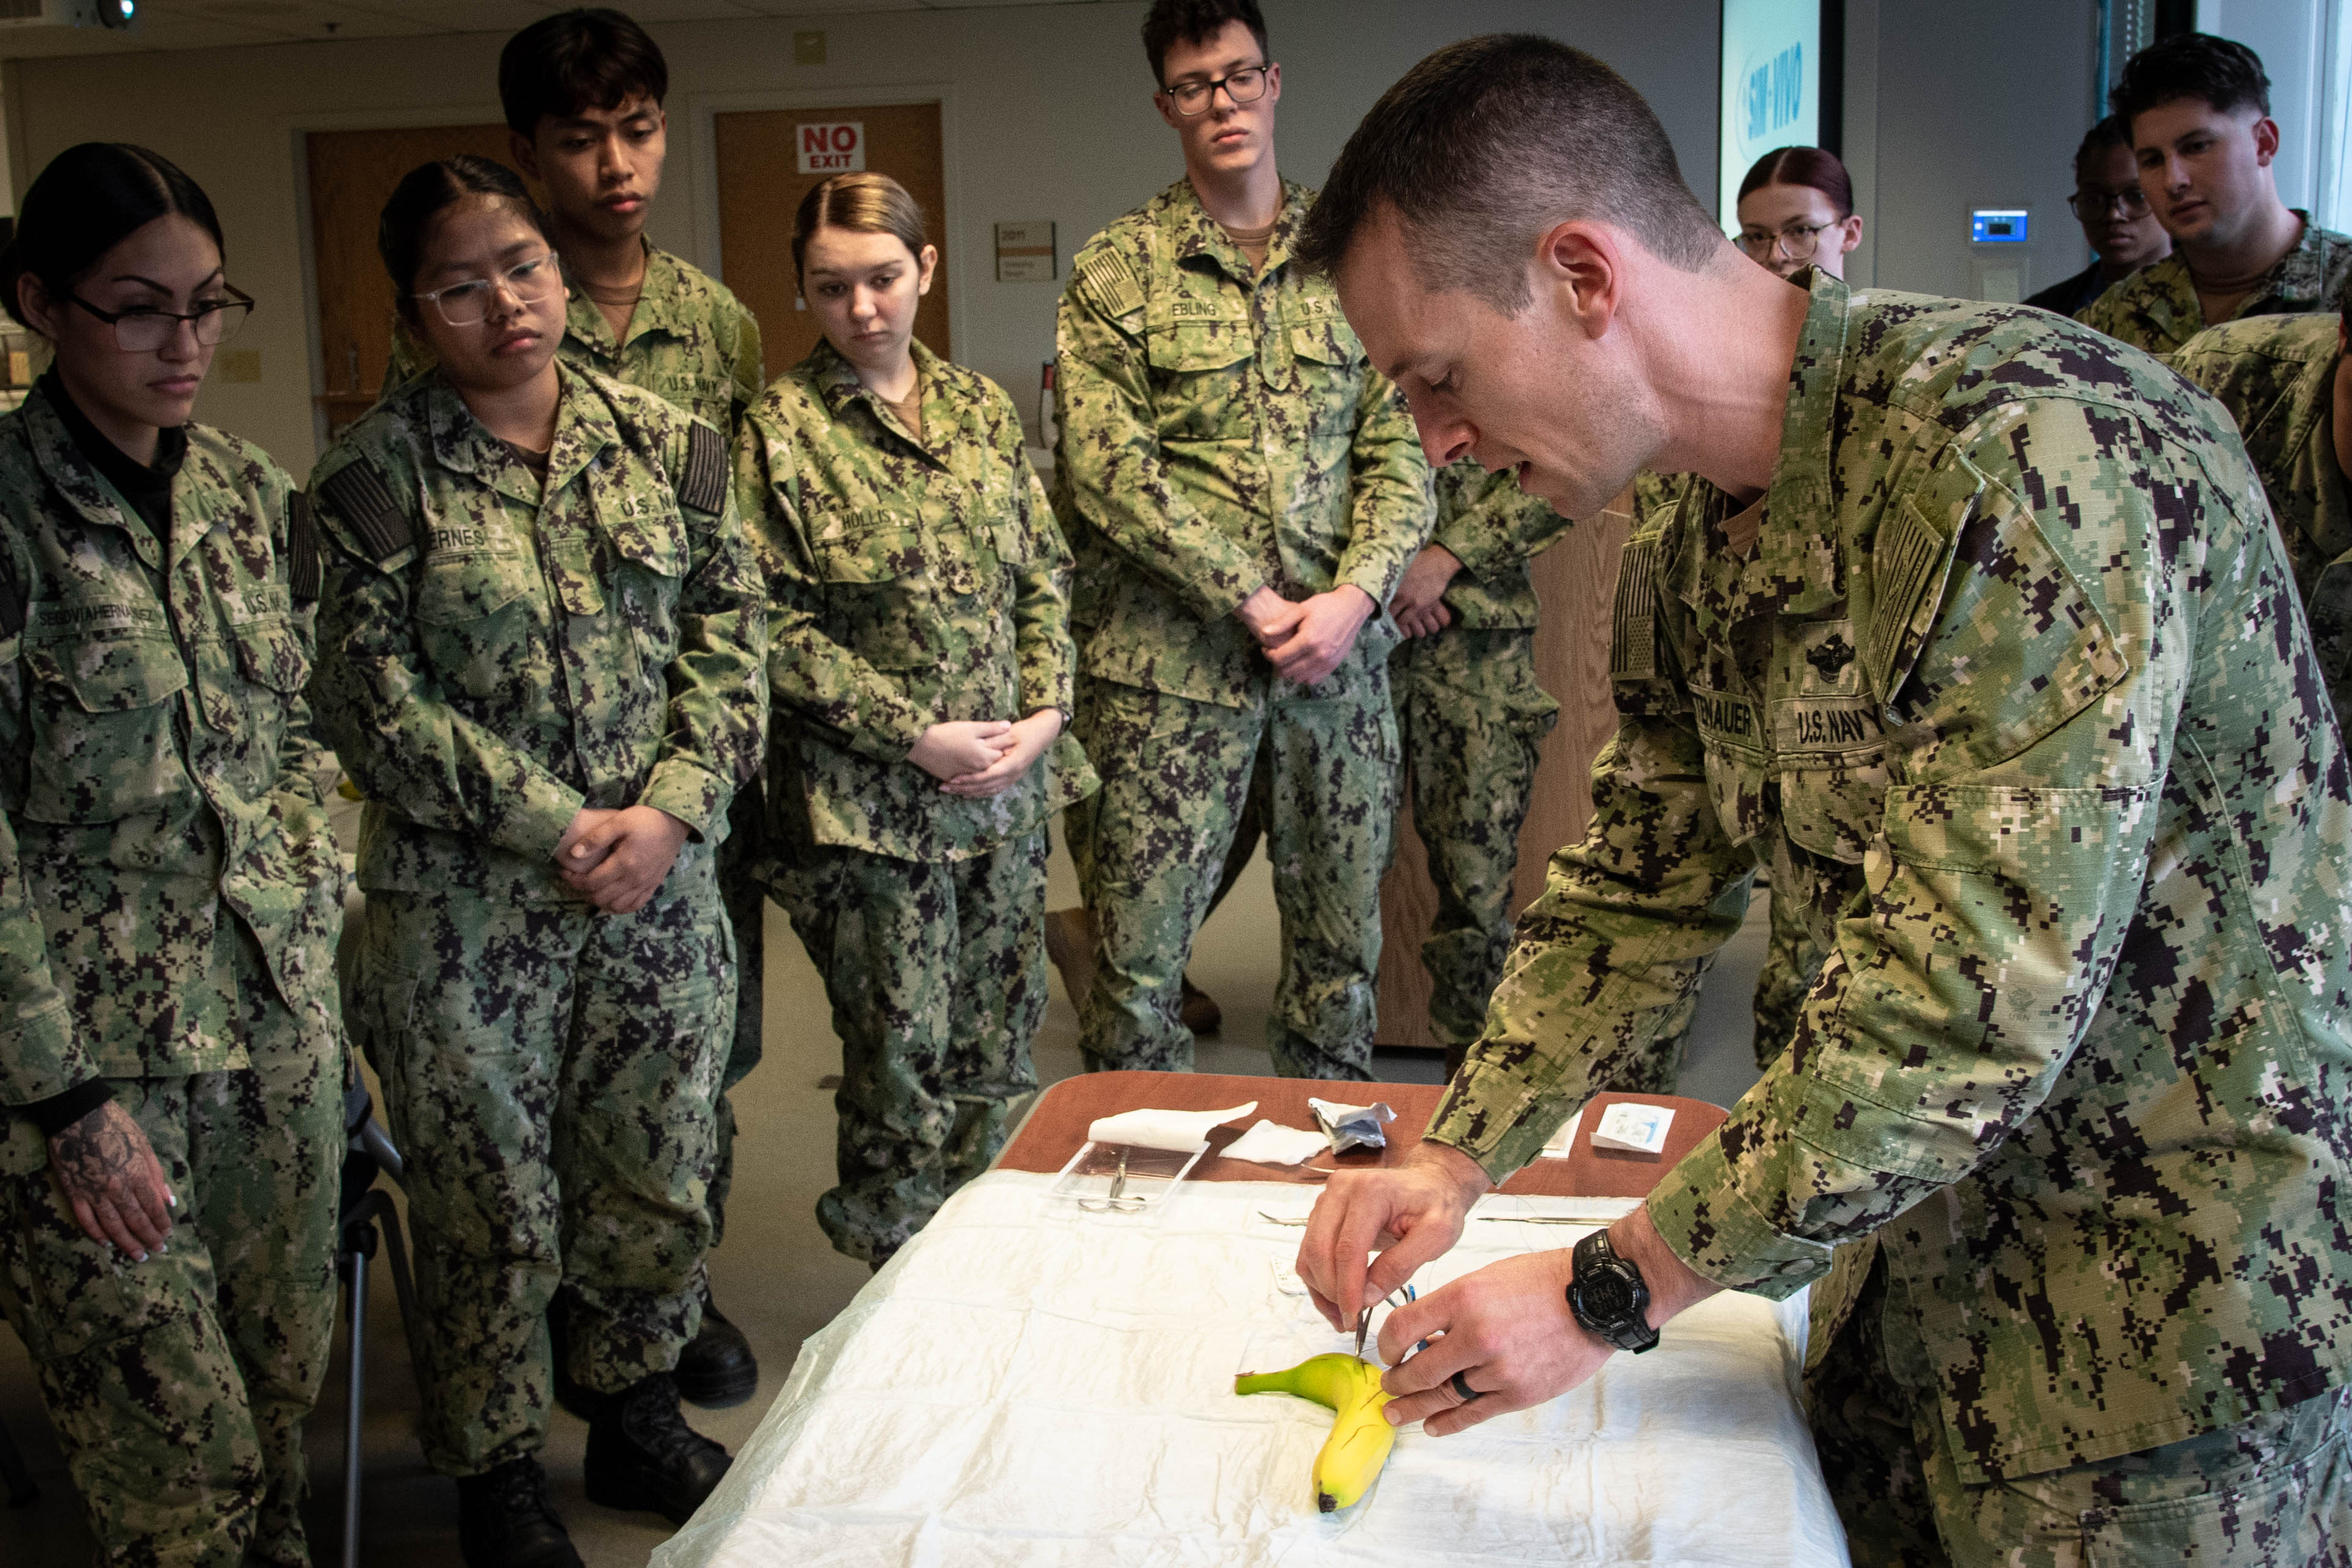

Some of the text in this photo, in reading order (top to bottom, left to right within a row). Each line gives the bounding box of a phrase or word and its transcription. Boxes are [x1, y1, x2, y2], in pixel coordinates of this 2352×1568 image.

[804, 126, 856, 152] NO
[810, 155, 852, 168] EXIT
[1172, 302, 1216, 316] EBLING
[1301, 300, 1327, 315] U.S.
[667, 376, 693, 392] U.S.
[842, 509, 891, 530] HOLLIS
[1798, 704, 1885, 744] U.S. NAVY
